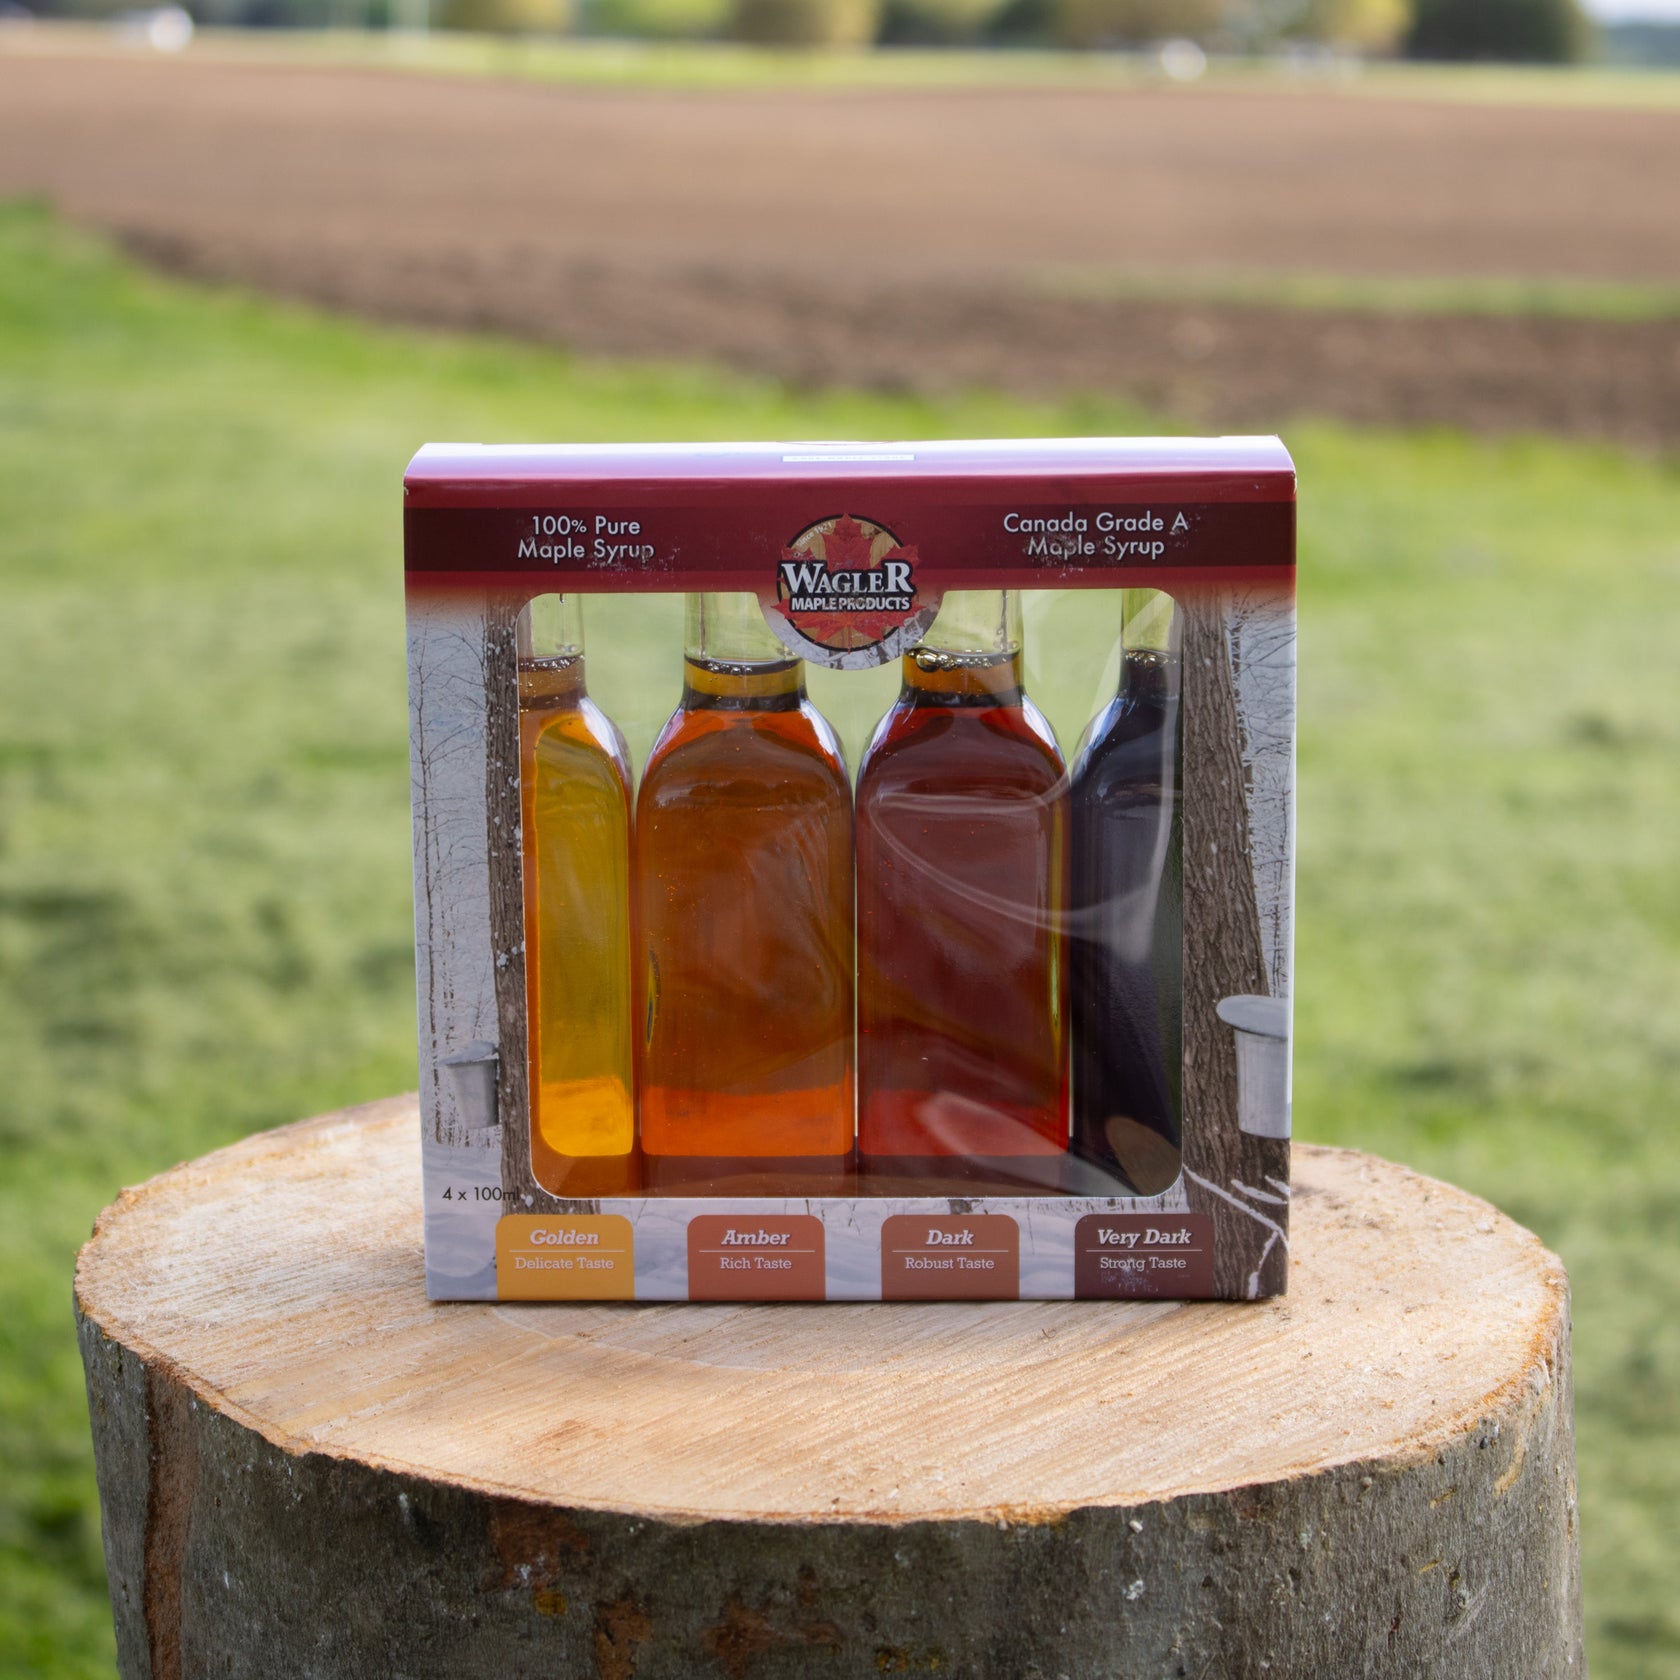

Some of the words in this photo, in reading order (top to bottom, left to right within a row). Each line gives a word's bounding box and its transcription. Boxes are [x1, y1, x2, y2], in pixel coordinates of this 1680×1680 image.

[532, 515, 587, 535] 100%
[595, 515, 641, 535] Pure
[1003, 511, 1087, 532] Canada
[1096, 511, 1164, 531] Grade
[1171, 512, 1189, 530] A
[518, 537, 585, 564] Maple
[593, 538, 655, 564] Syrup
[1028, 534, 1096, 560] Maple
[1104, 535, 1165, 560] Syrup
[791, 597, 837, 611] MAPLE
[838, 597, 910, 611] PRODUCTS
[442, 1186, 453, 1201] 4
[458, 1191, 467, 1201] x
[474, 1186, 521, 1201] 100ml
[529, 1229, 599, 1246] Golden
[720, 1229, 790, 1246] Amber
[926, 1229, 974, 1246] Dark
[1097, 1229, 1141, 1248] Very
[1143, 1228, 1192, 1245] Dark
[515, 1257, 573, 1270] Delicate
[577, 1257, 614, 1270] Taste
[720, 1257, 751, 1270] Rich
[755, 1257, 792, 1270] Taste
[905, 1257, 953, 1270] Robust
[956, 1257, 995, 1270] Taste
[1100, 1257, 1146, 1272] Strong
[1148, 1257, 1187, 1269] Taste
